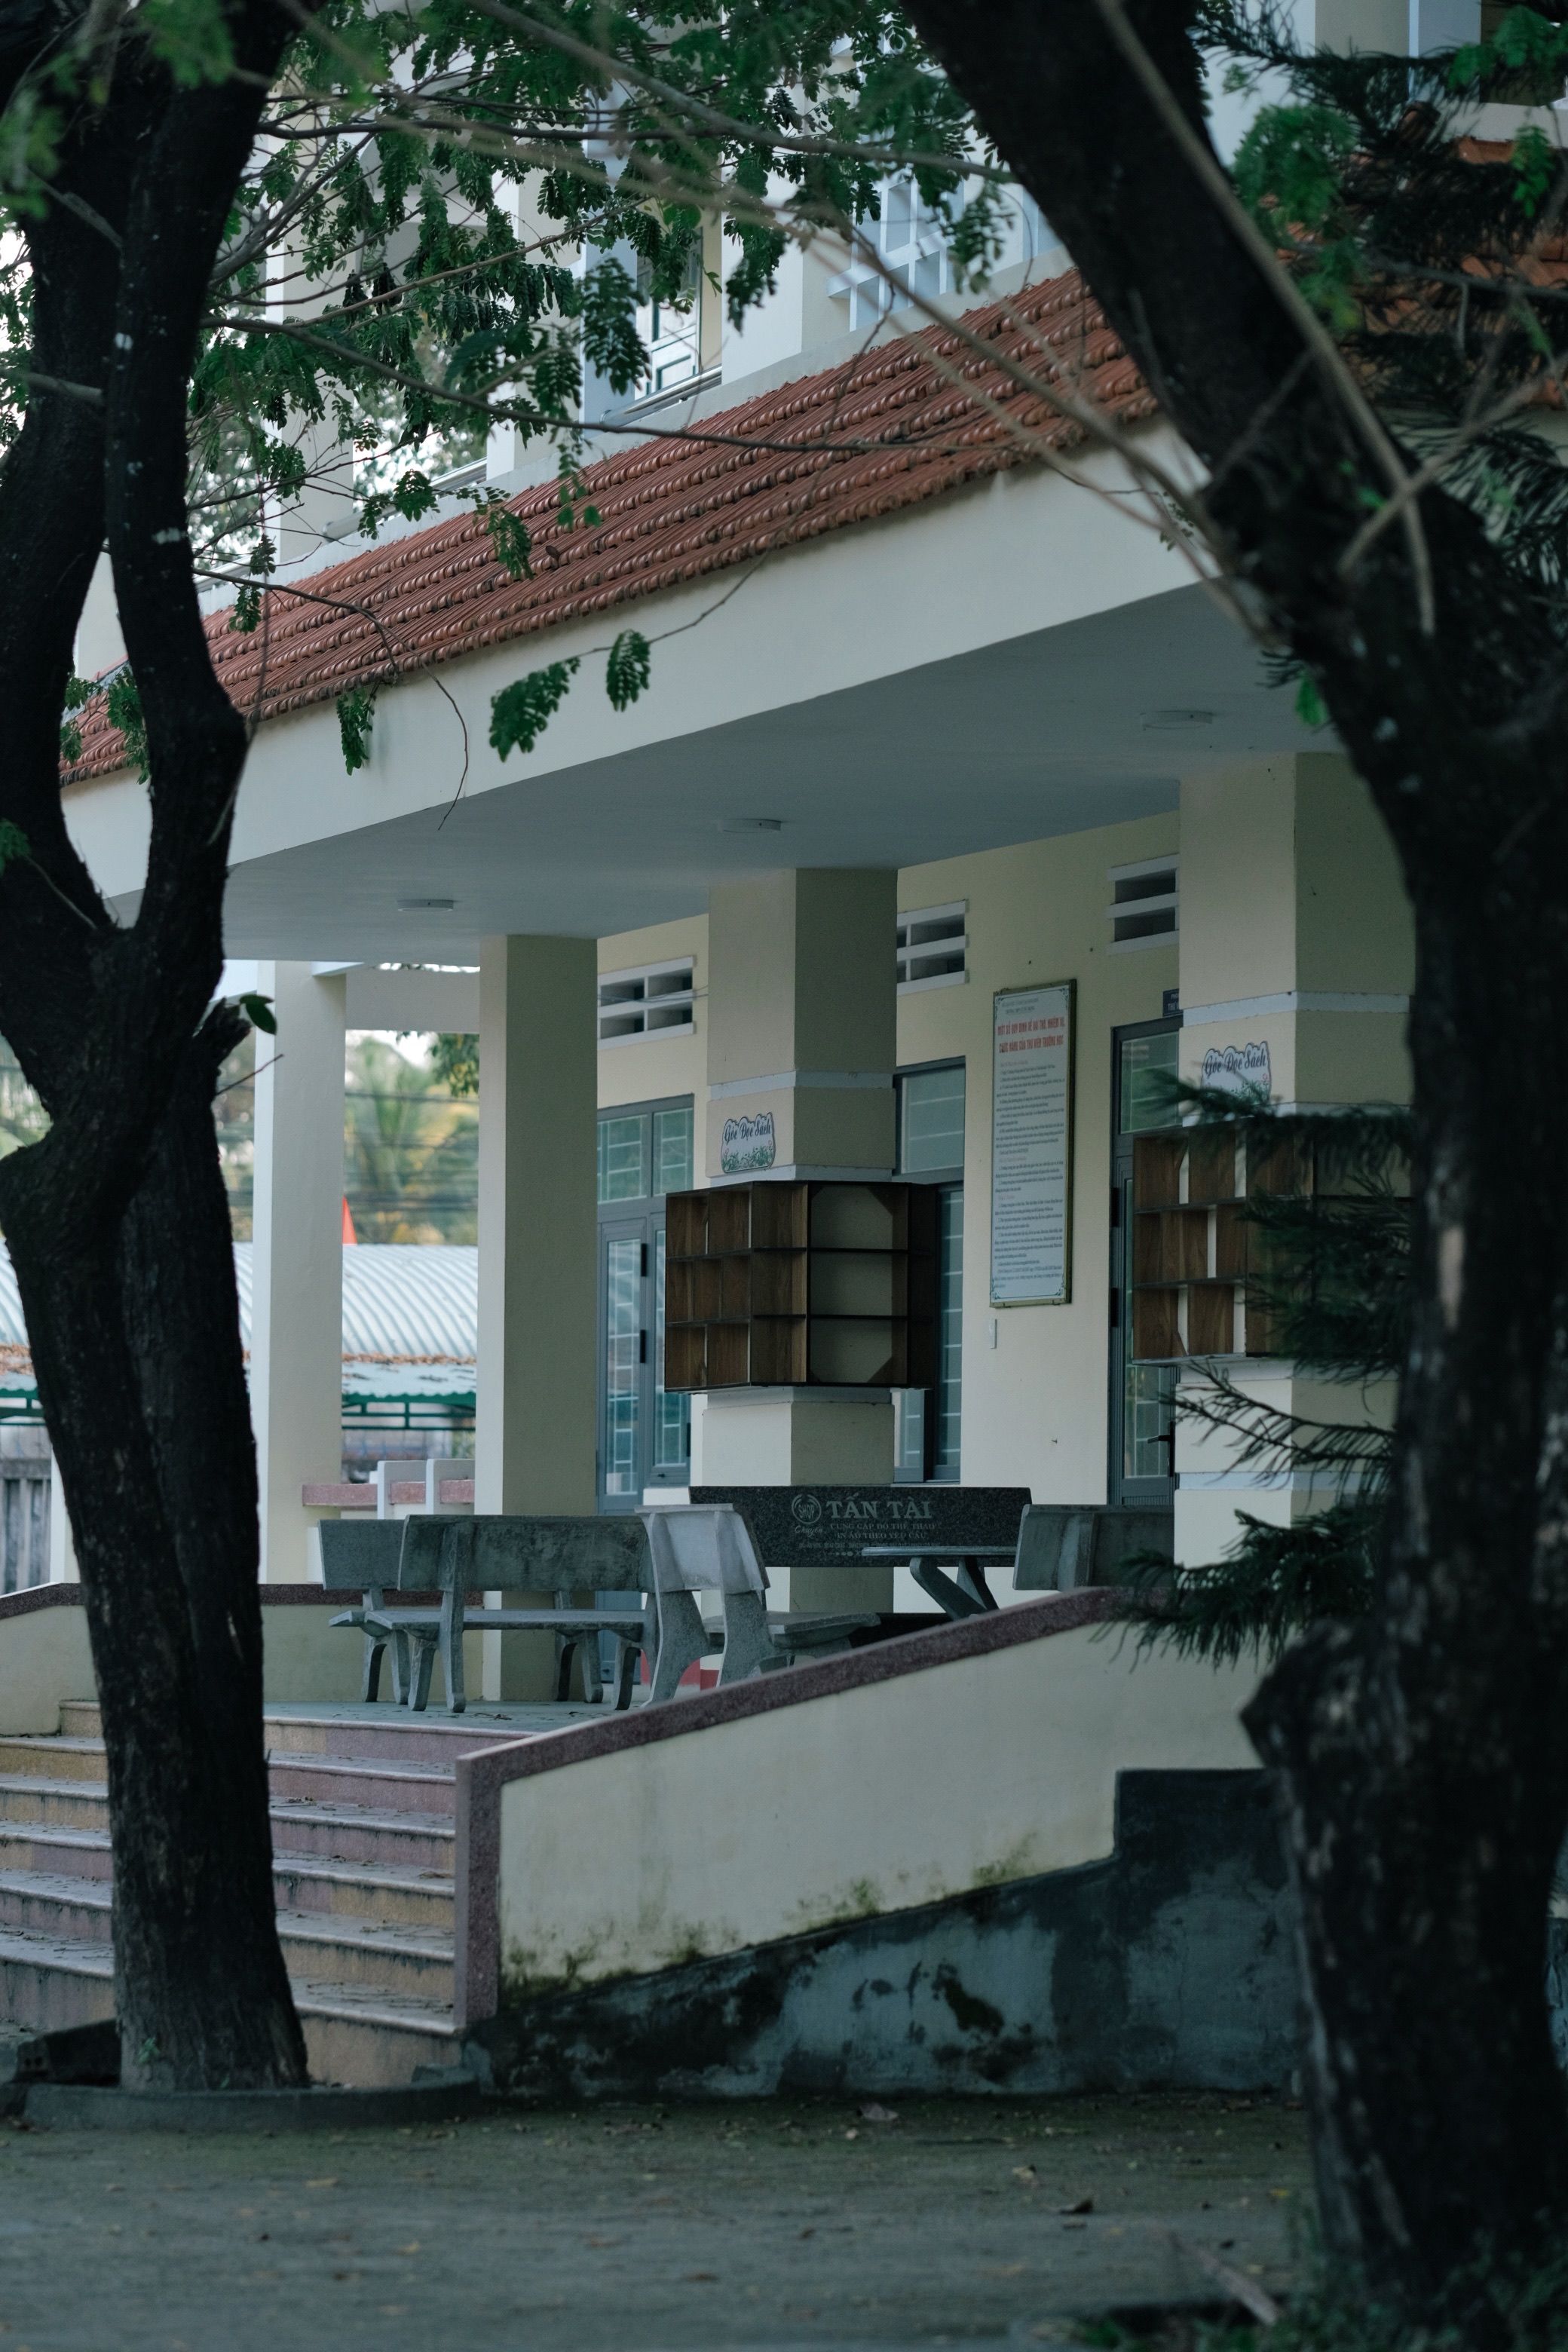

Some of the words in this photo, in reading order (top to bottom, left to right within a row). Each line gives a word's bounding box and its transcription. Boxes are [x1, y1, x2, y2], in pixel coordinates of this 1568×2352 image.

[1245, 1048, 1266, 1069] Sách
[755, 1118, 771, 1137] Sách
[798, 1503, 815, 1520] SHOP
[825, 1493, 882, 1519] TẤN
[887, 1496, 933, 1519] TÀI
